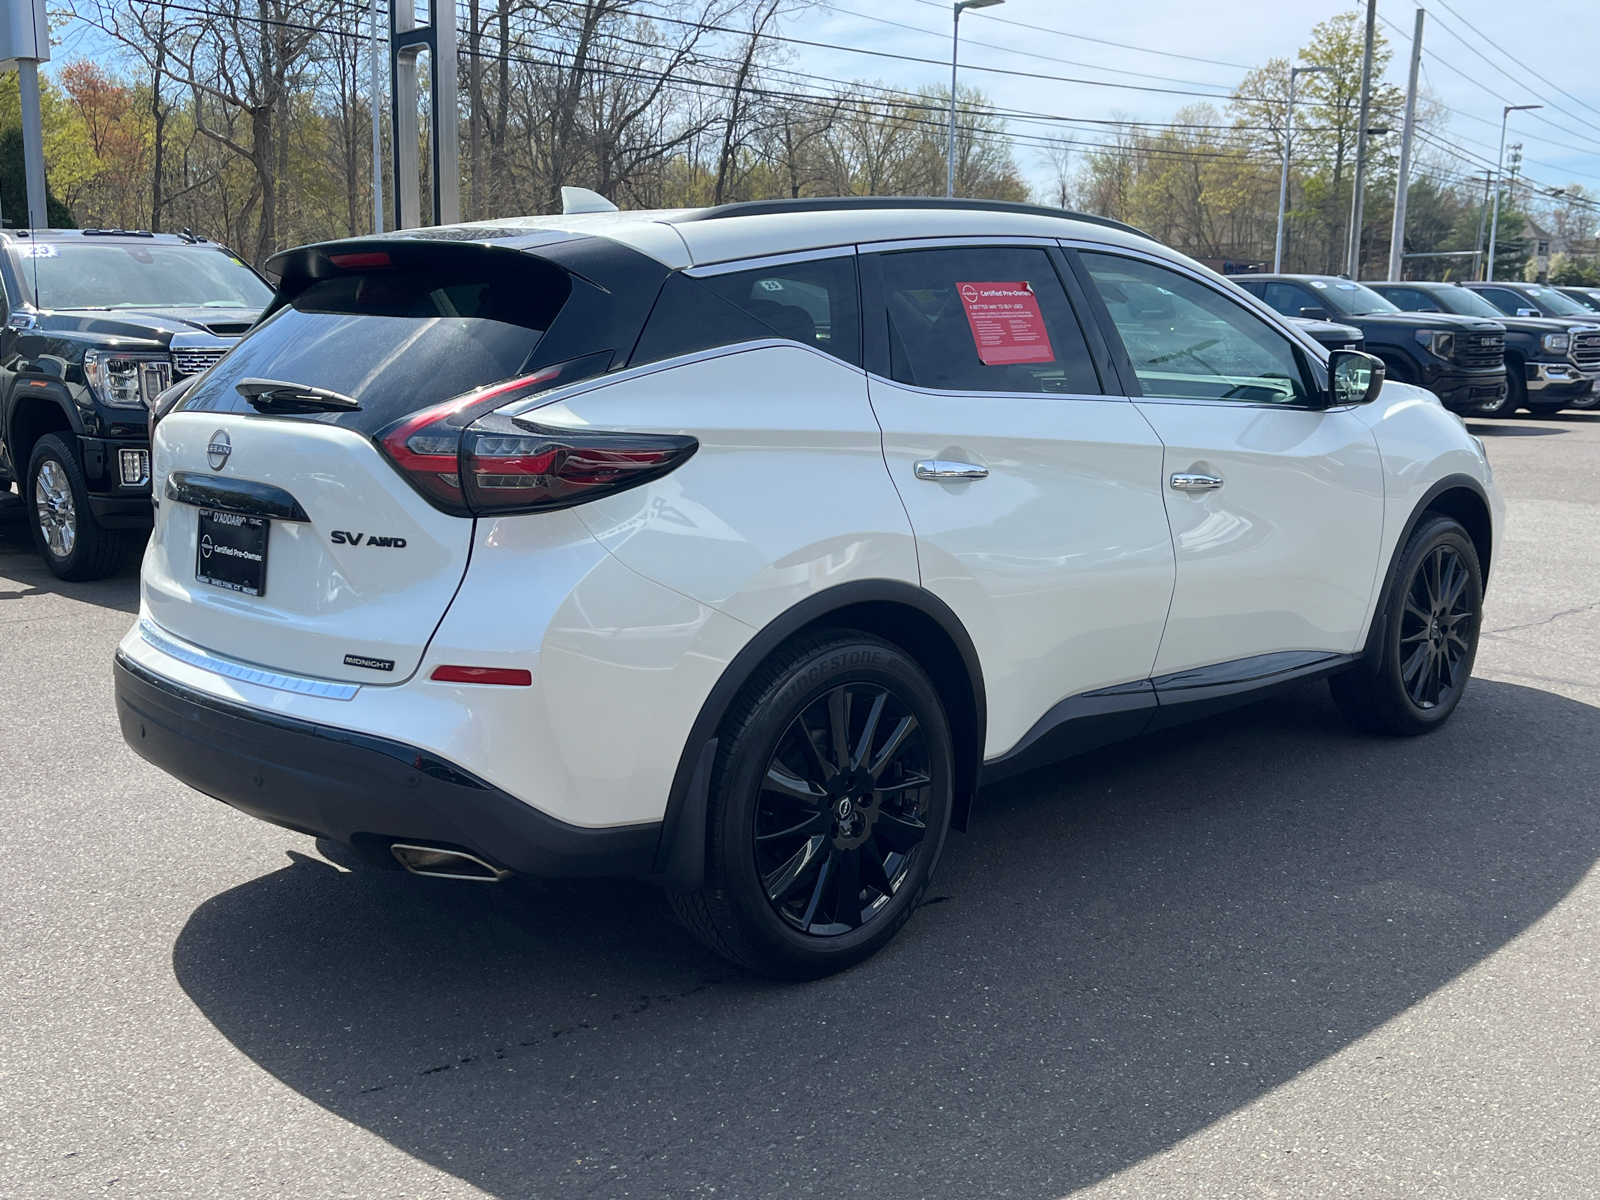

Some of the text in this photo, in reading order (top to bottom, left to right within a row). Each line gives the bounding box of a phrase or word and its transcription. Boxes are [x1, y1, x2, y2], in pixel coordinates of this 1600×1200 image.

[29, 247, 49, 255] 23
[206, 445, 231, 454] SSAN
[331, 530, 407, 548] SV AWD
[214, 545, 233, 556] Certified
[345, 656, 390, 669] MIDNIGHT
[769, 651, 881, 718] BRIDGESTONE
